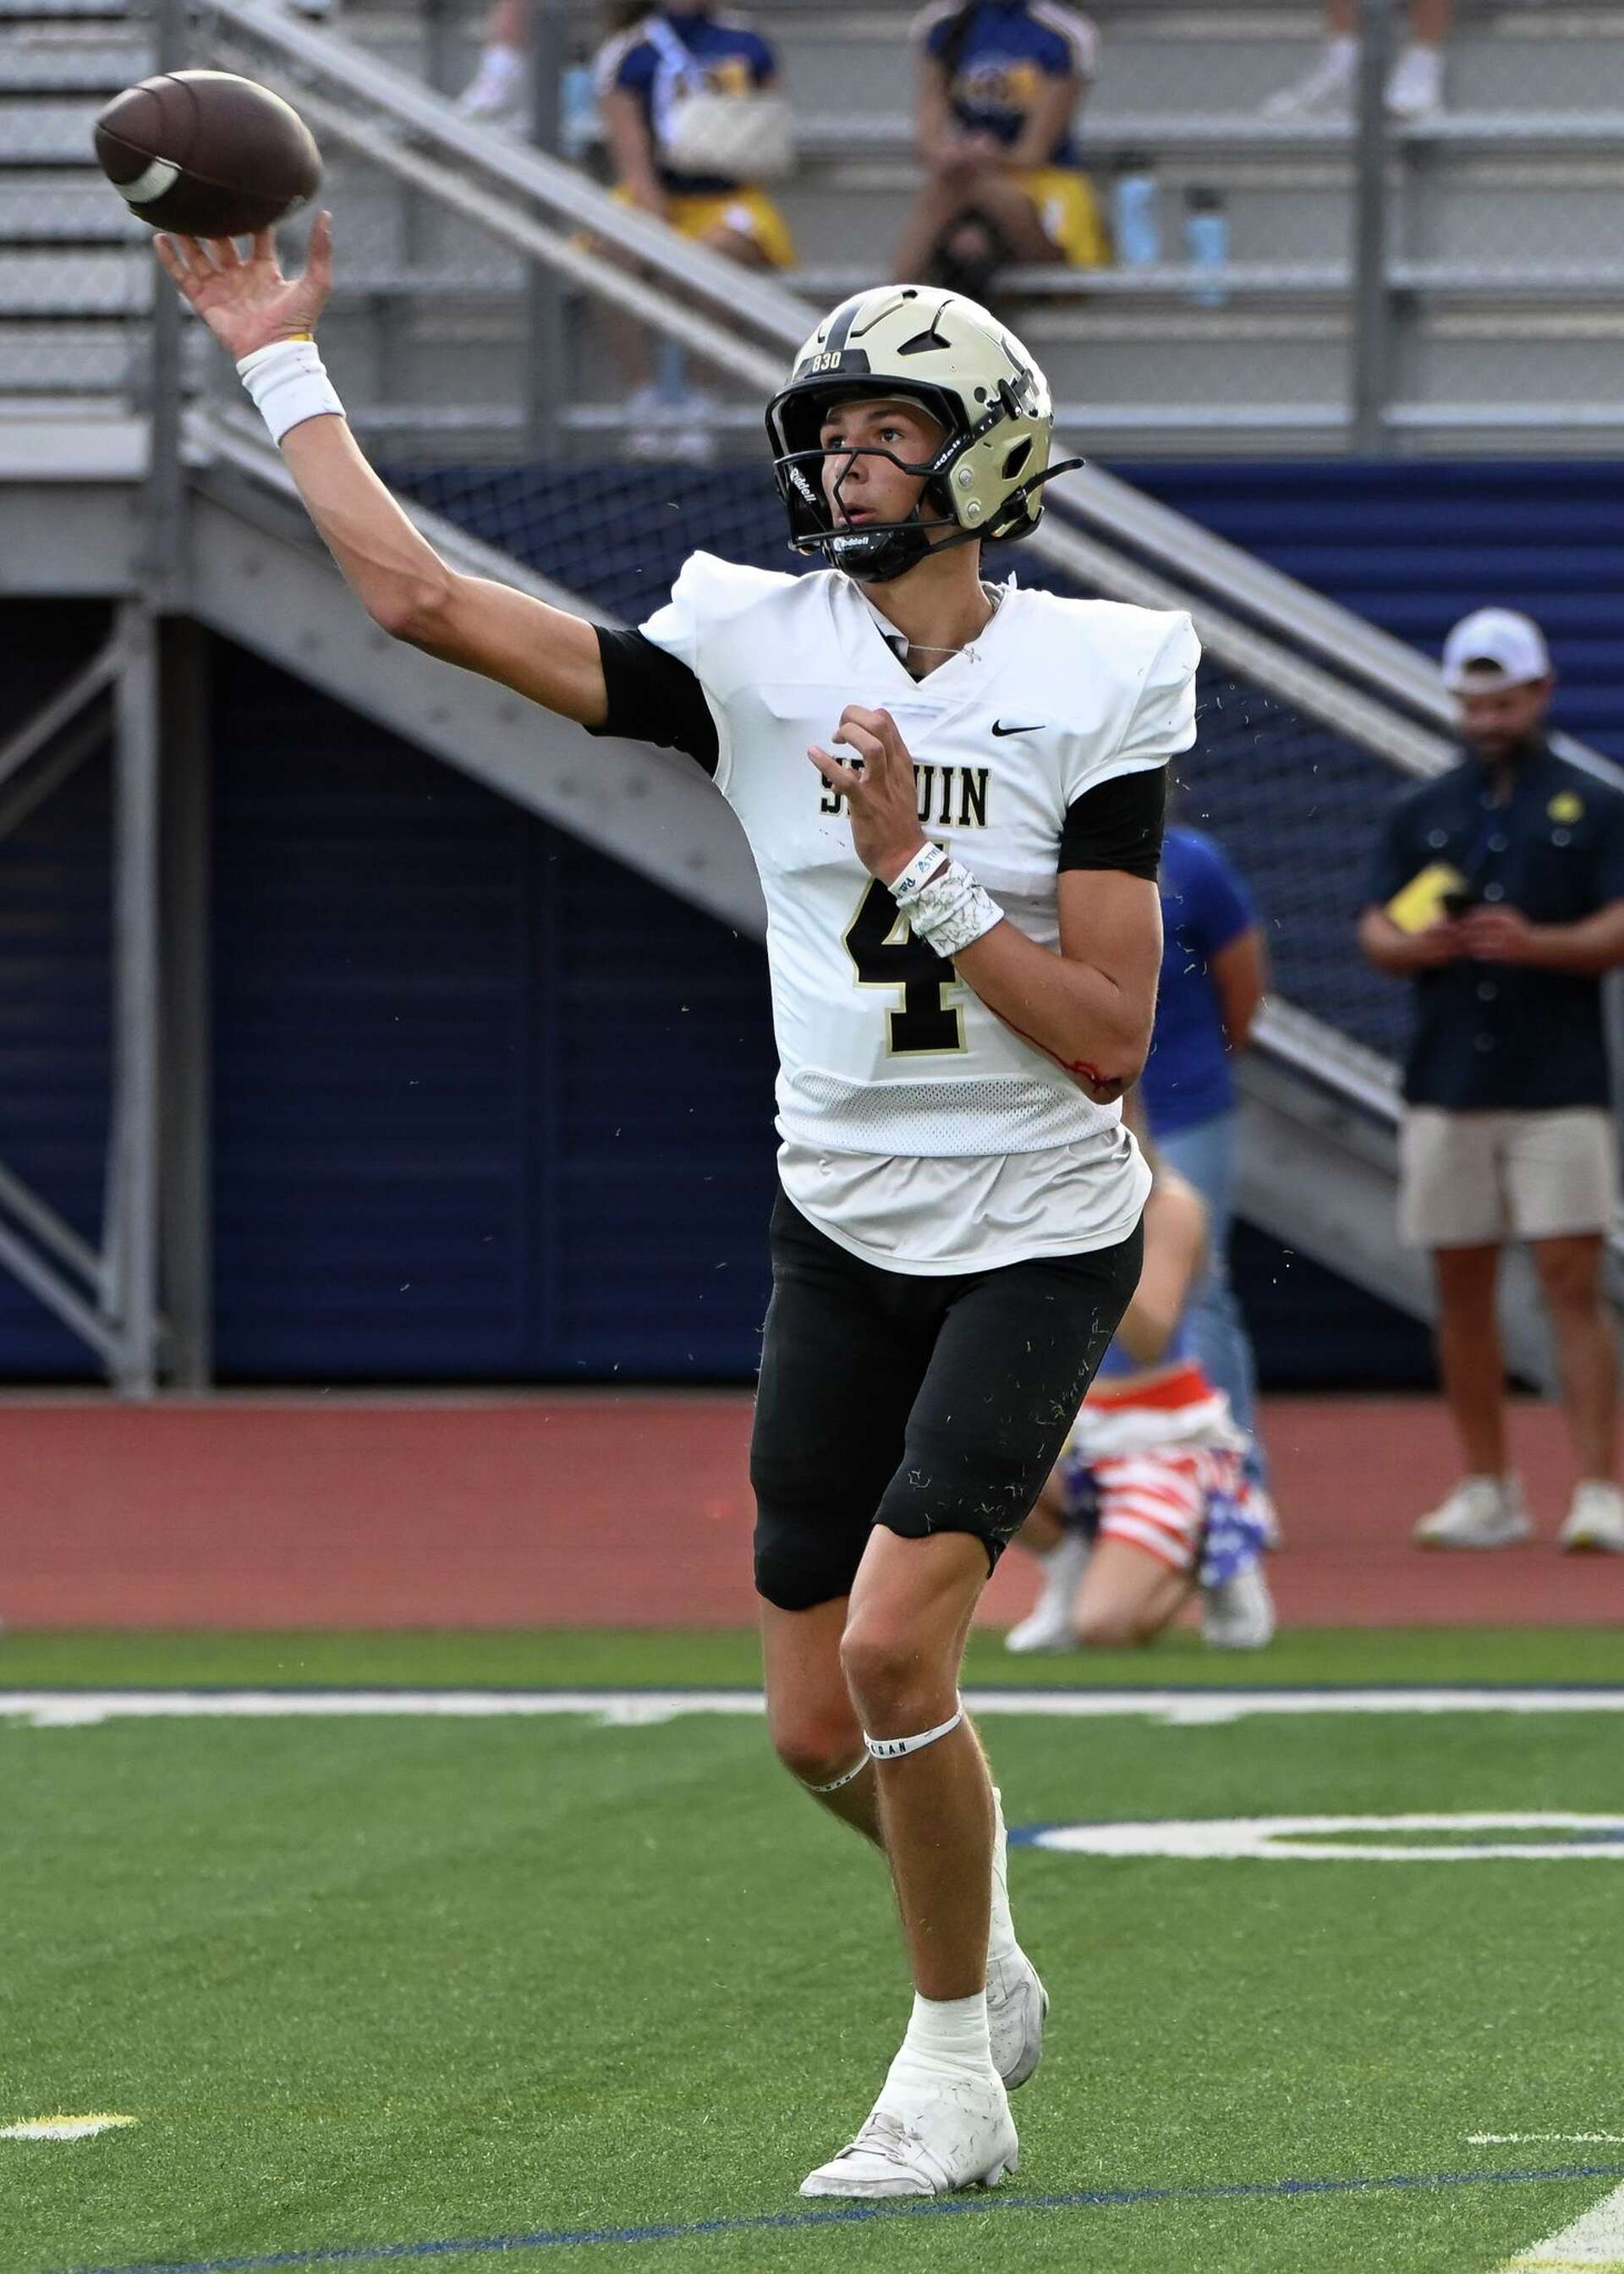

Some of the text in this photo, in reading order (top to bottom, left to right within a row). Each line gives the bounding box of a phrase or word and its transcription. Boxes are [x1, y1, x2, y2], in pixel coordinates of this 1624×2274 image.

[812, 351, 842, 372] 830
[820, 756, 991, 828] SUIN
[841, 839, 968, 1058] 4
